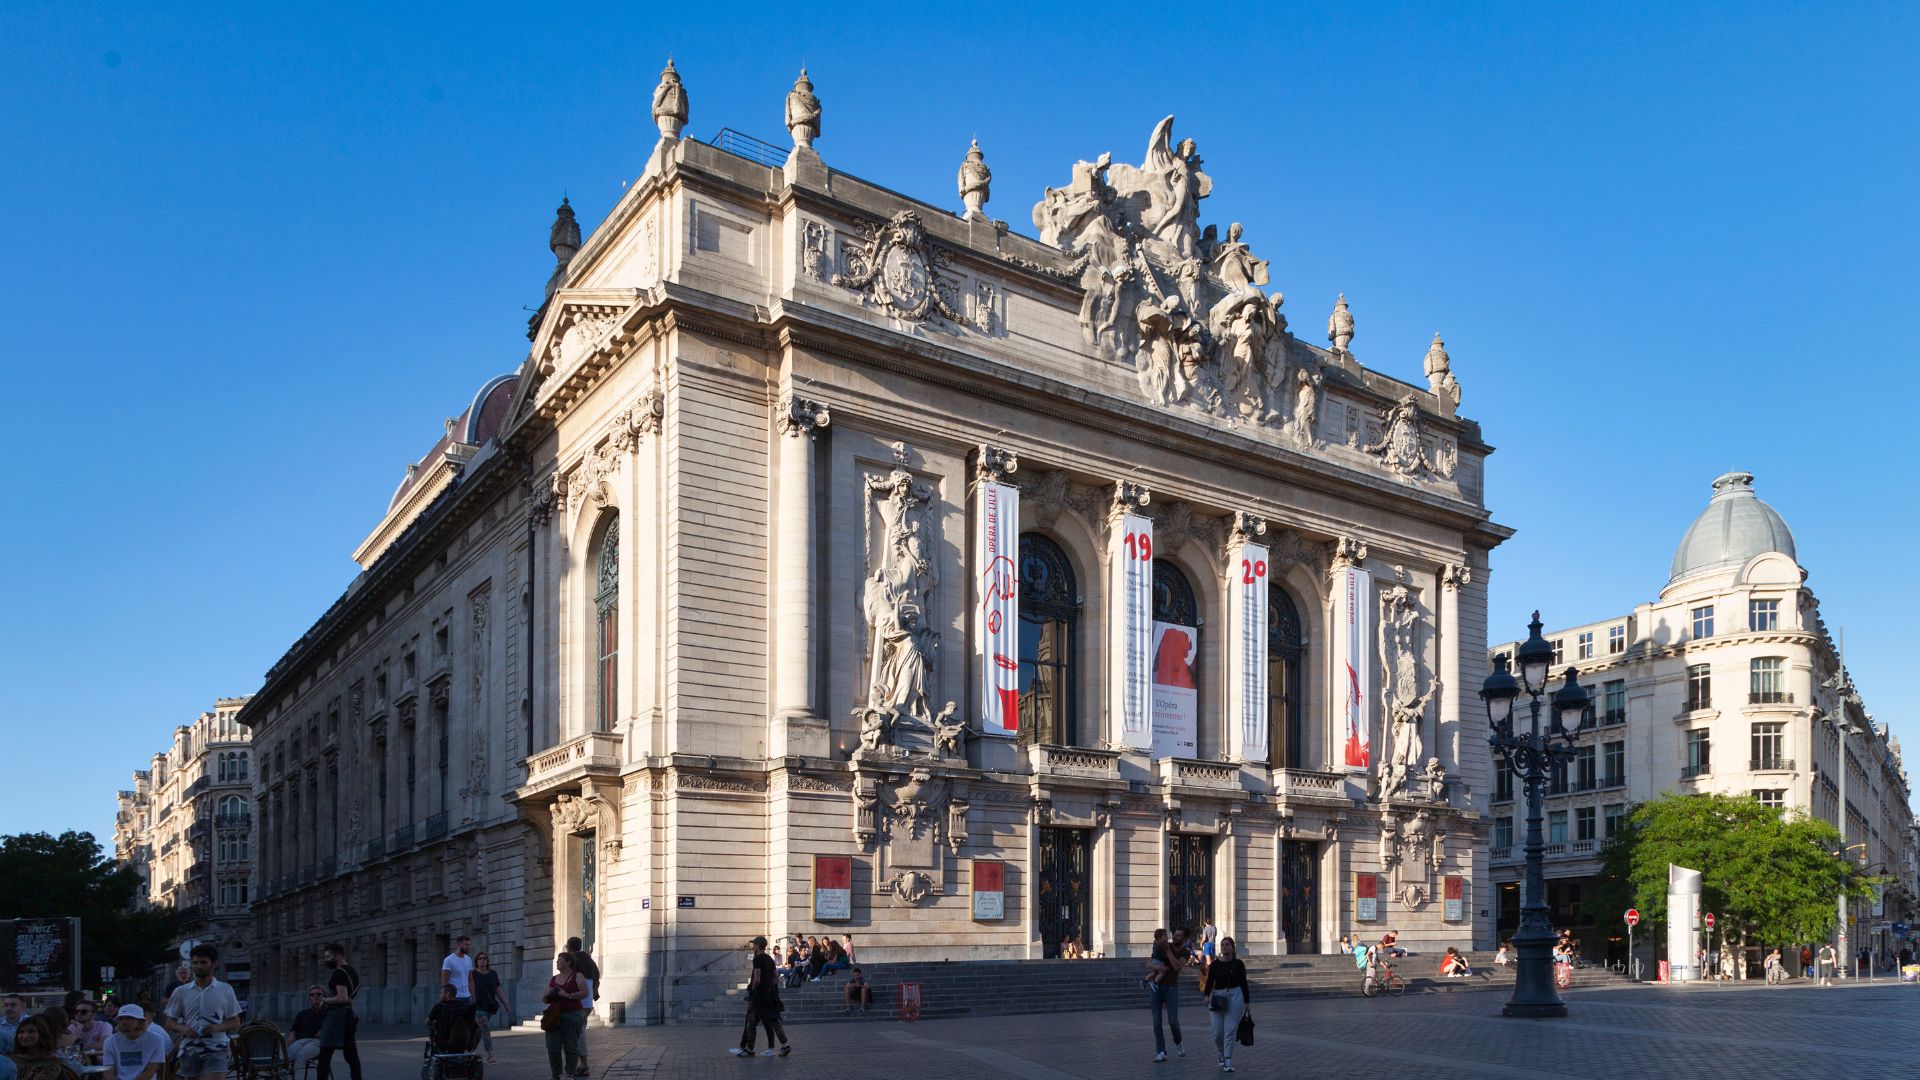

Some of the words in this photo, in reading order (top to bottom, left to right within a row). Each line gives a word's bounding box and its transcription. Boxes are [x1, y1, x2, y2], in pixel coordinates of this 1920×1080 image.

[988, 511, 996, 521] DE
[1124, 532, 1152, 561] 19
[1242, 559, 1266, 584] 20
